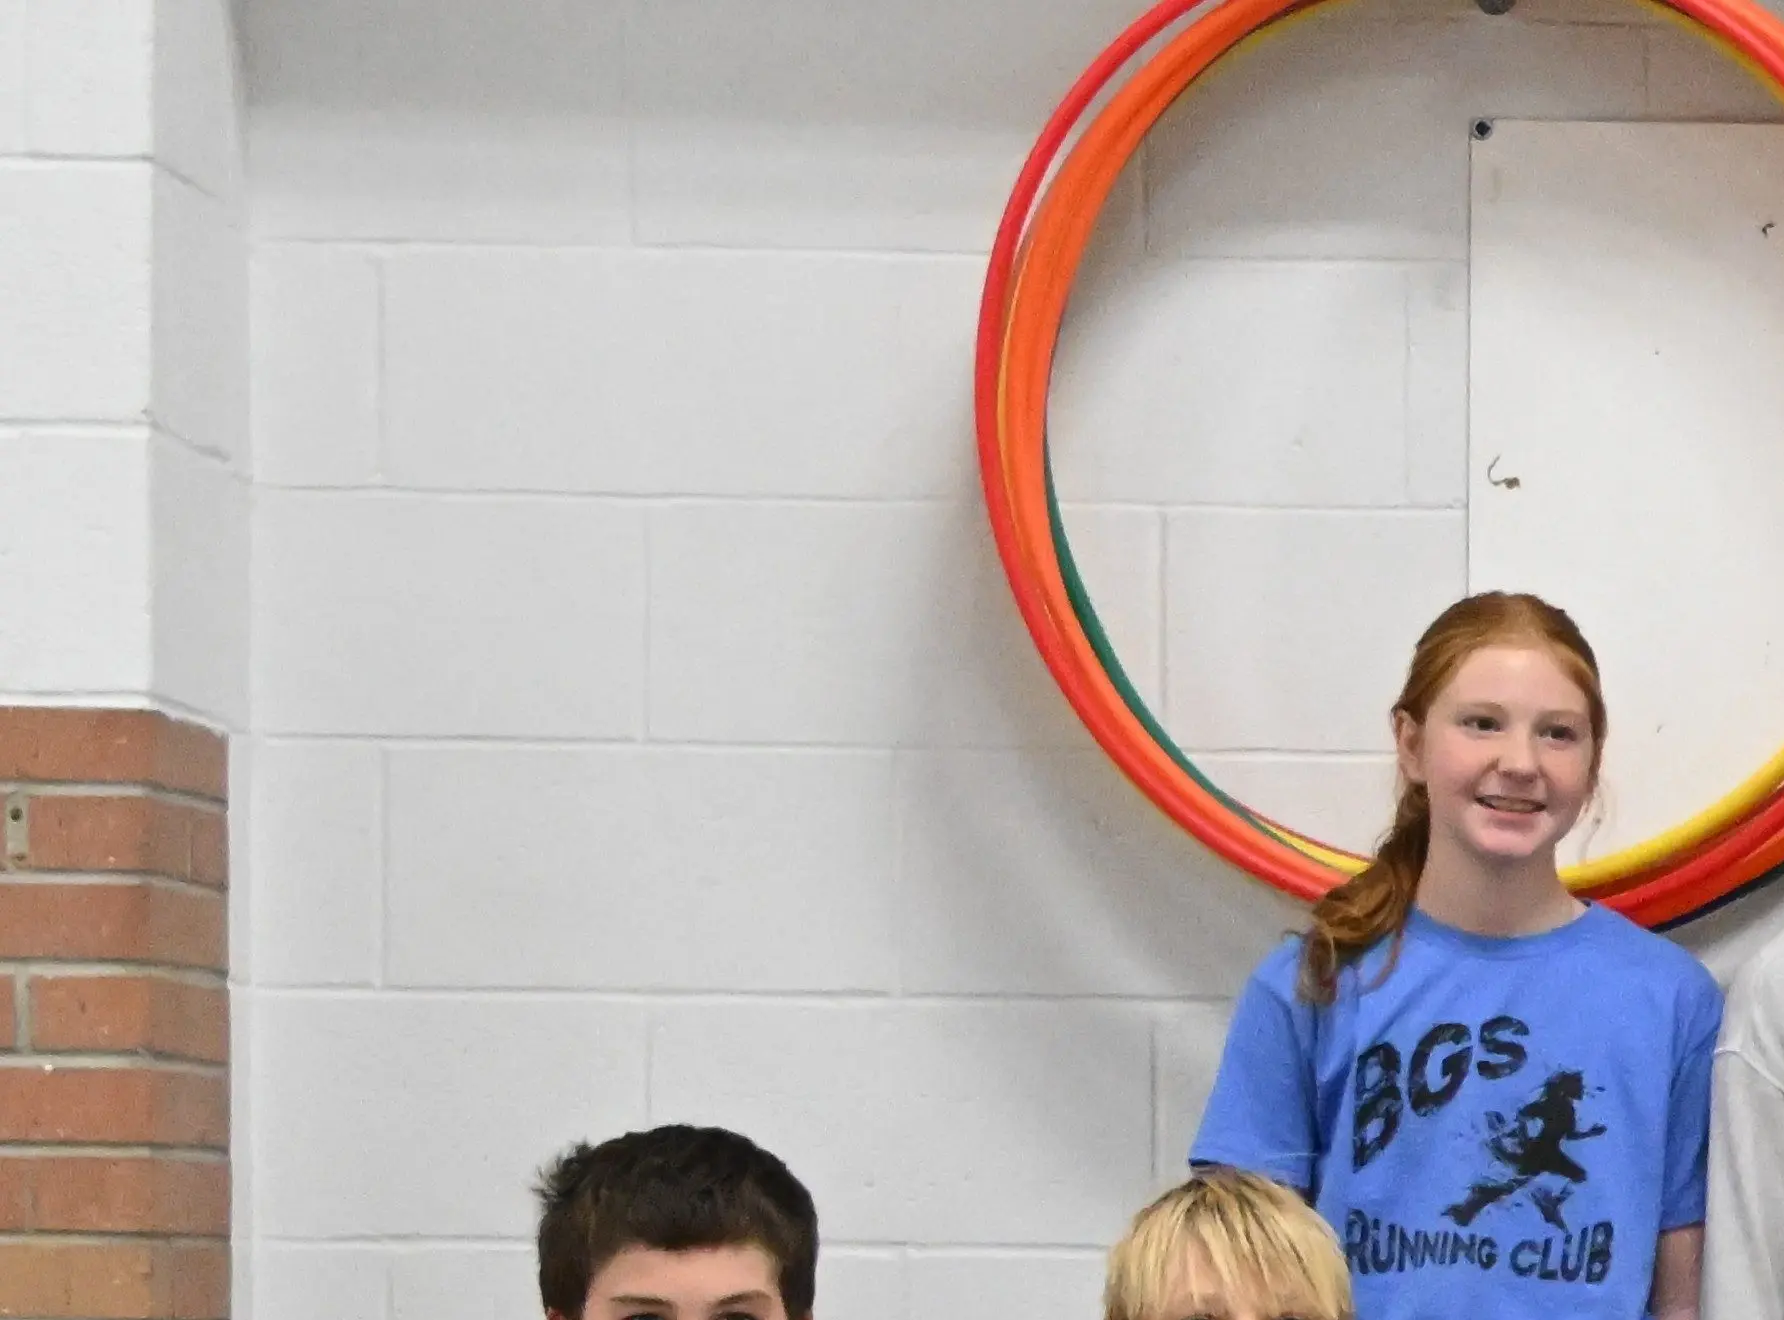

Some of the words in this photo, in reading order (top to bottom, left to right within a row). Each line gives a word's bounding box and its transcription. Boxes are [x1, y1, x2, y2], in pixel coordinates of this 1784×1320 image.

[1352, 1015, 1530, 1174] BGS
[1345, 1208, 1498, 1275] RUNNING
[1509, 1220, 1615, 1285] CLUB
